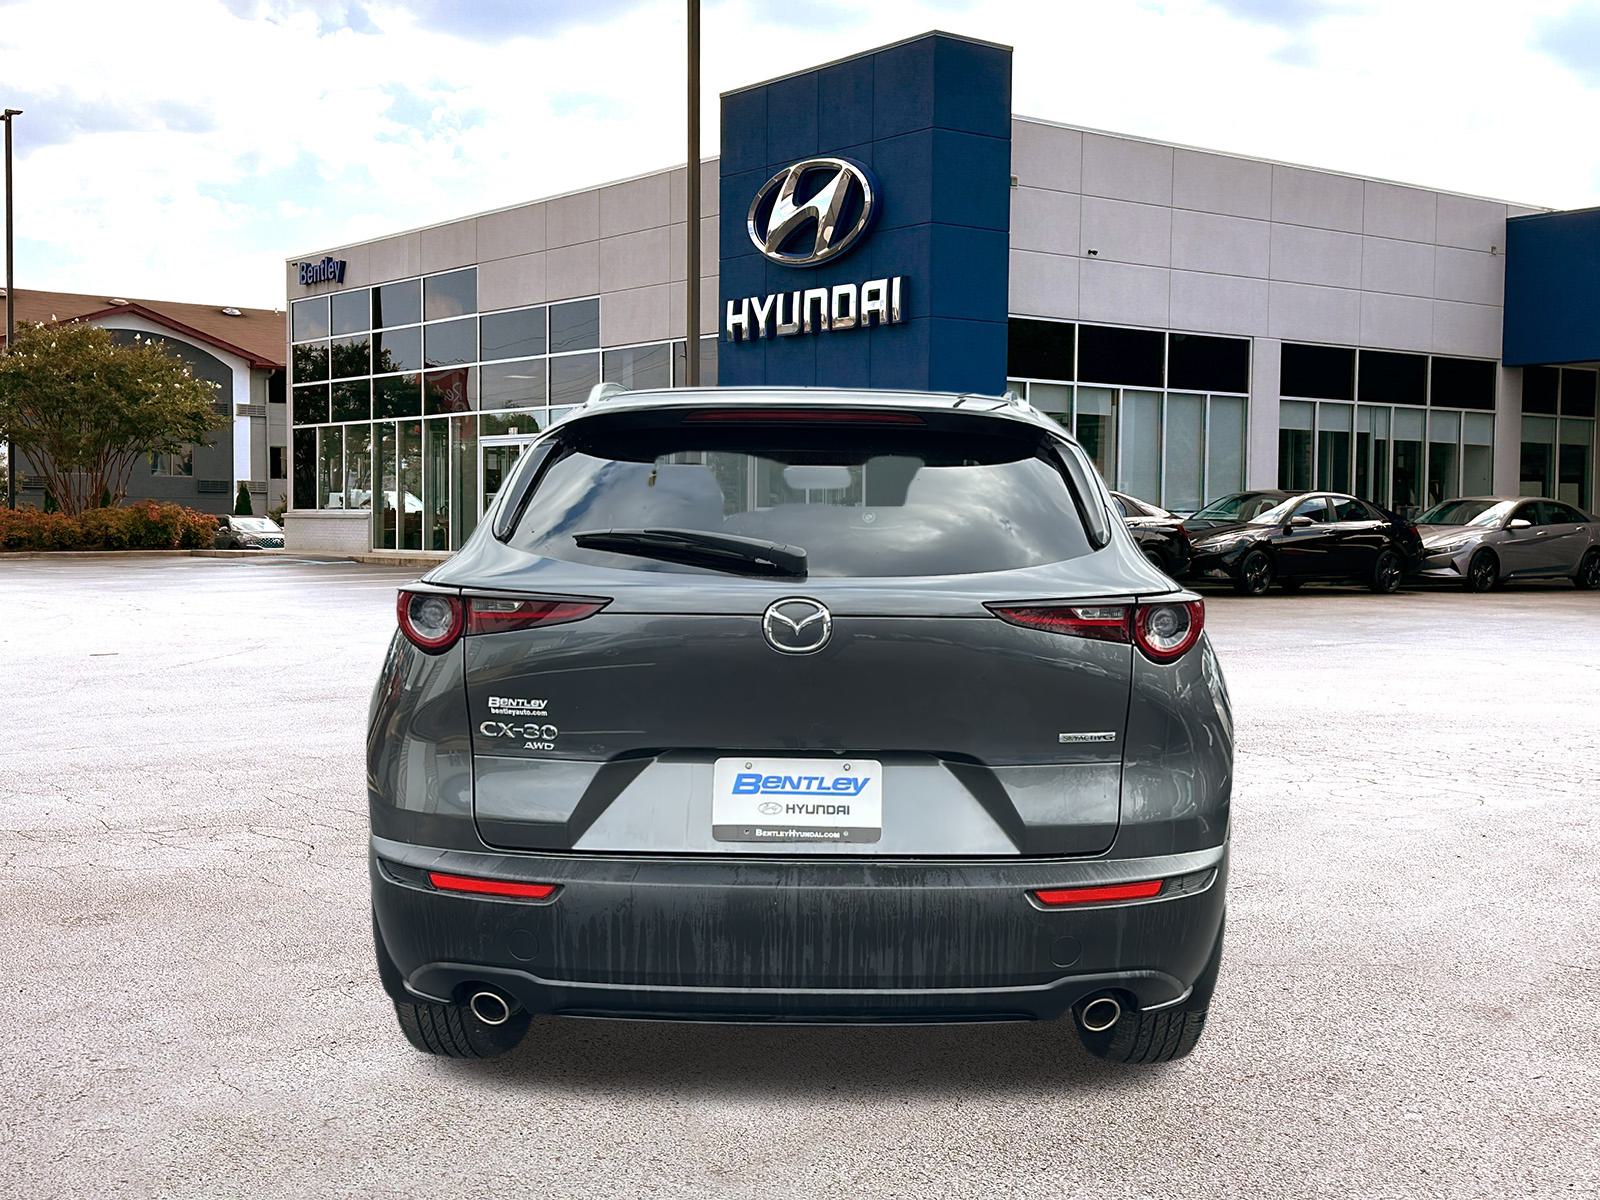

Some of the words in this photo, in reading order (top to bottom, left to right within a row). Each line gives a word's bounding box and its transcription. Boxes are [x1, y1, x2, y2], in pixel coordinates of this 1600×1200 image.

[299, 257, 343, 285] Bentley
[726, 276, 903, 342] HYUNDAI
[490, 707, 548, 717] bentleyauto.com
[479, 721, 558, 740] CX-30
[523, 741, 555, 750] AWD
[786, 804, 850, 815] HYUNDAI
